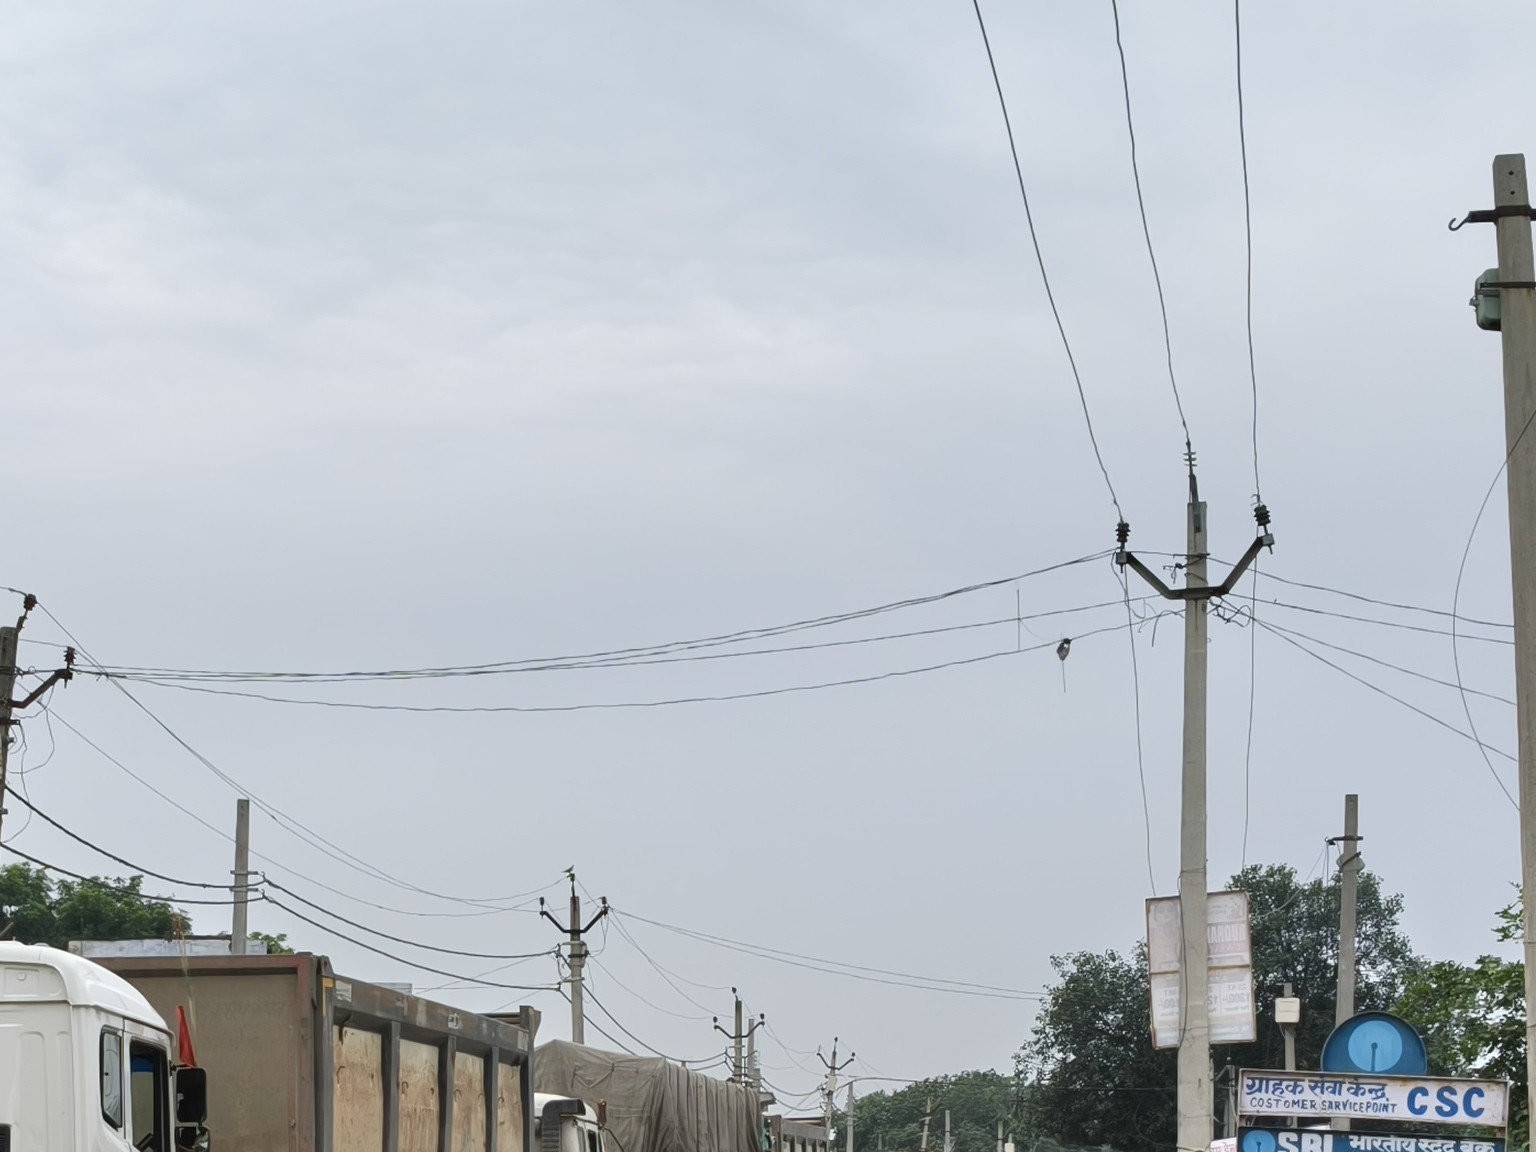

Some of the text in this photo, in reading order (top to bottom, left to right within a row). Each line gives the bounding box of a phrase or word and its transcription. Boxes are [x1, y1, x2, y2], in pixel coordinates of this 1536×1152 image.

[1245, 1076, 1305, 1098] ग्राहक
[1250, 1097, 1317, 1110] COSTOMER
[1407, 1086, 1485, 1118] CSC
